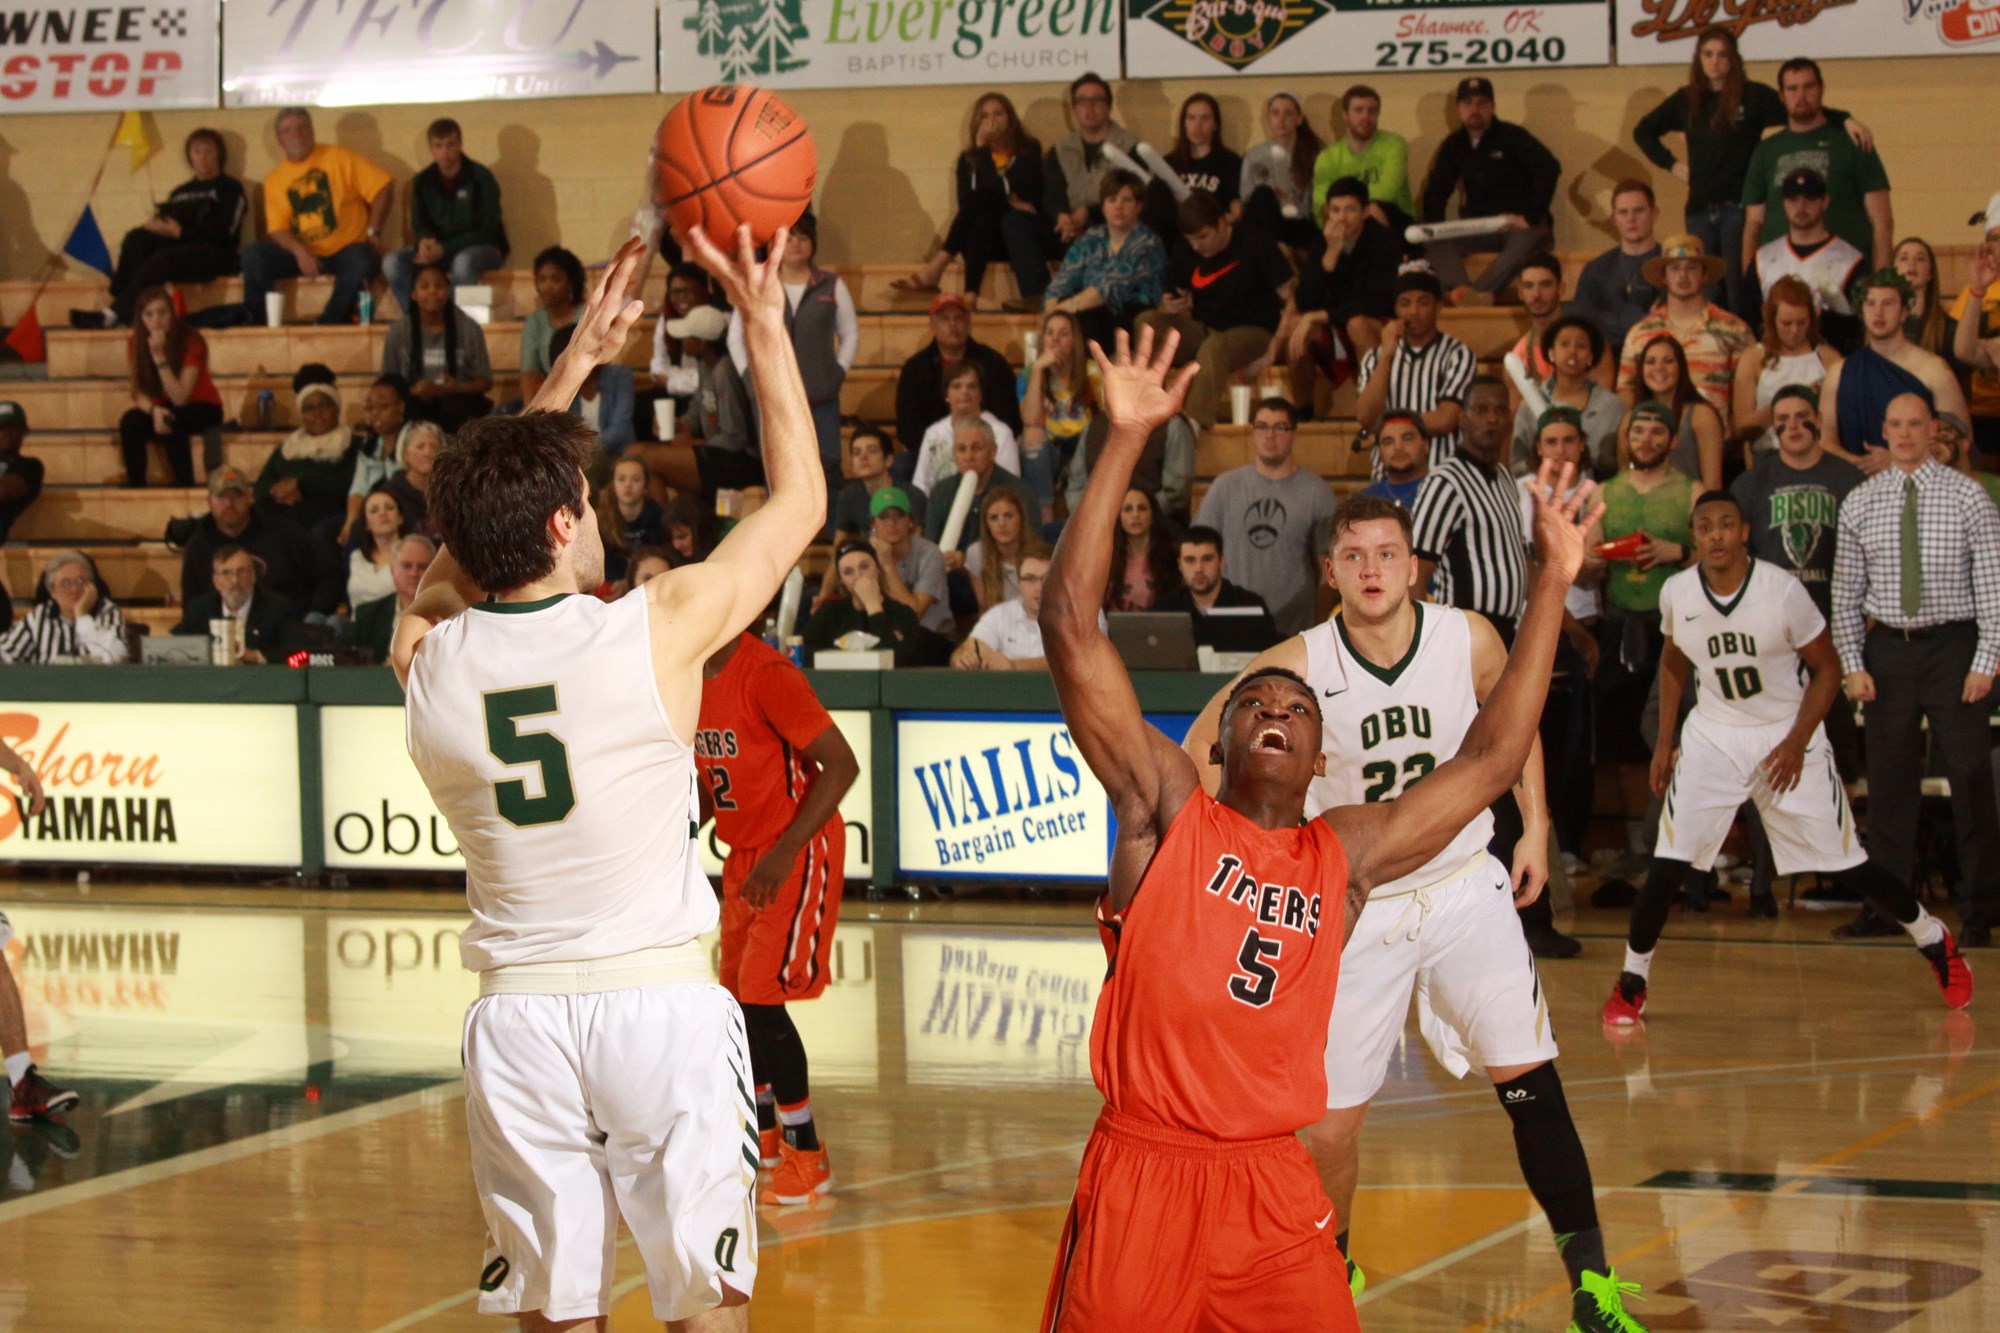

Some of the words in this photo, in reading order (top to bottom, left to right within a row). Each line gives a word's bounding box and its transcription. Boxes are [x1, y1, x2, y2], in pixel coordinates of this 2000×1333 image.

[823, 0, 1116, 60] Evergreen
[1503, 9, 1545, 34] OK
[0, 50, 183, 100] STOP
[847, 53, 946, 73] BAPTIST
[985, 49, 1089, 69] CHURCH
[1375, 37, 1566, 67] 275-2040
[1768, 491, 1837, 529] BISON
[1707, 631, 1758, 659] OBU
[1714, 666, 1764, 701] 10
[1360, 705, 1432, 751] OBU
[480, 680, 580, 830] 5
[913, 729, 1081, 832] WALLS
[15, 795, 178, 843] YAMAHA
[935, 825, 1016, 866] Bargain
[1022, 810, 1087, 844] Center
[1227, 926, 1282, 1009] 5
